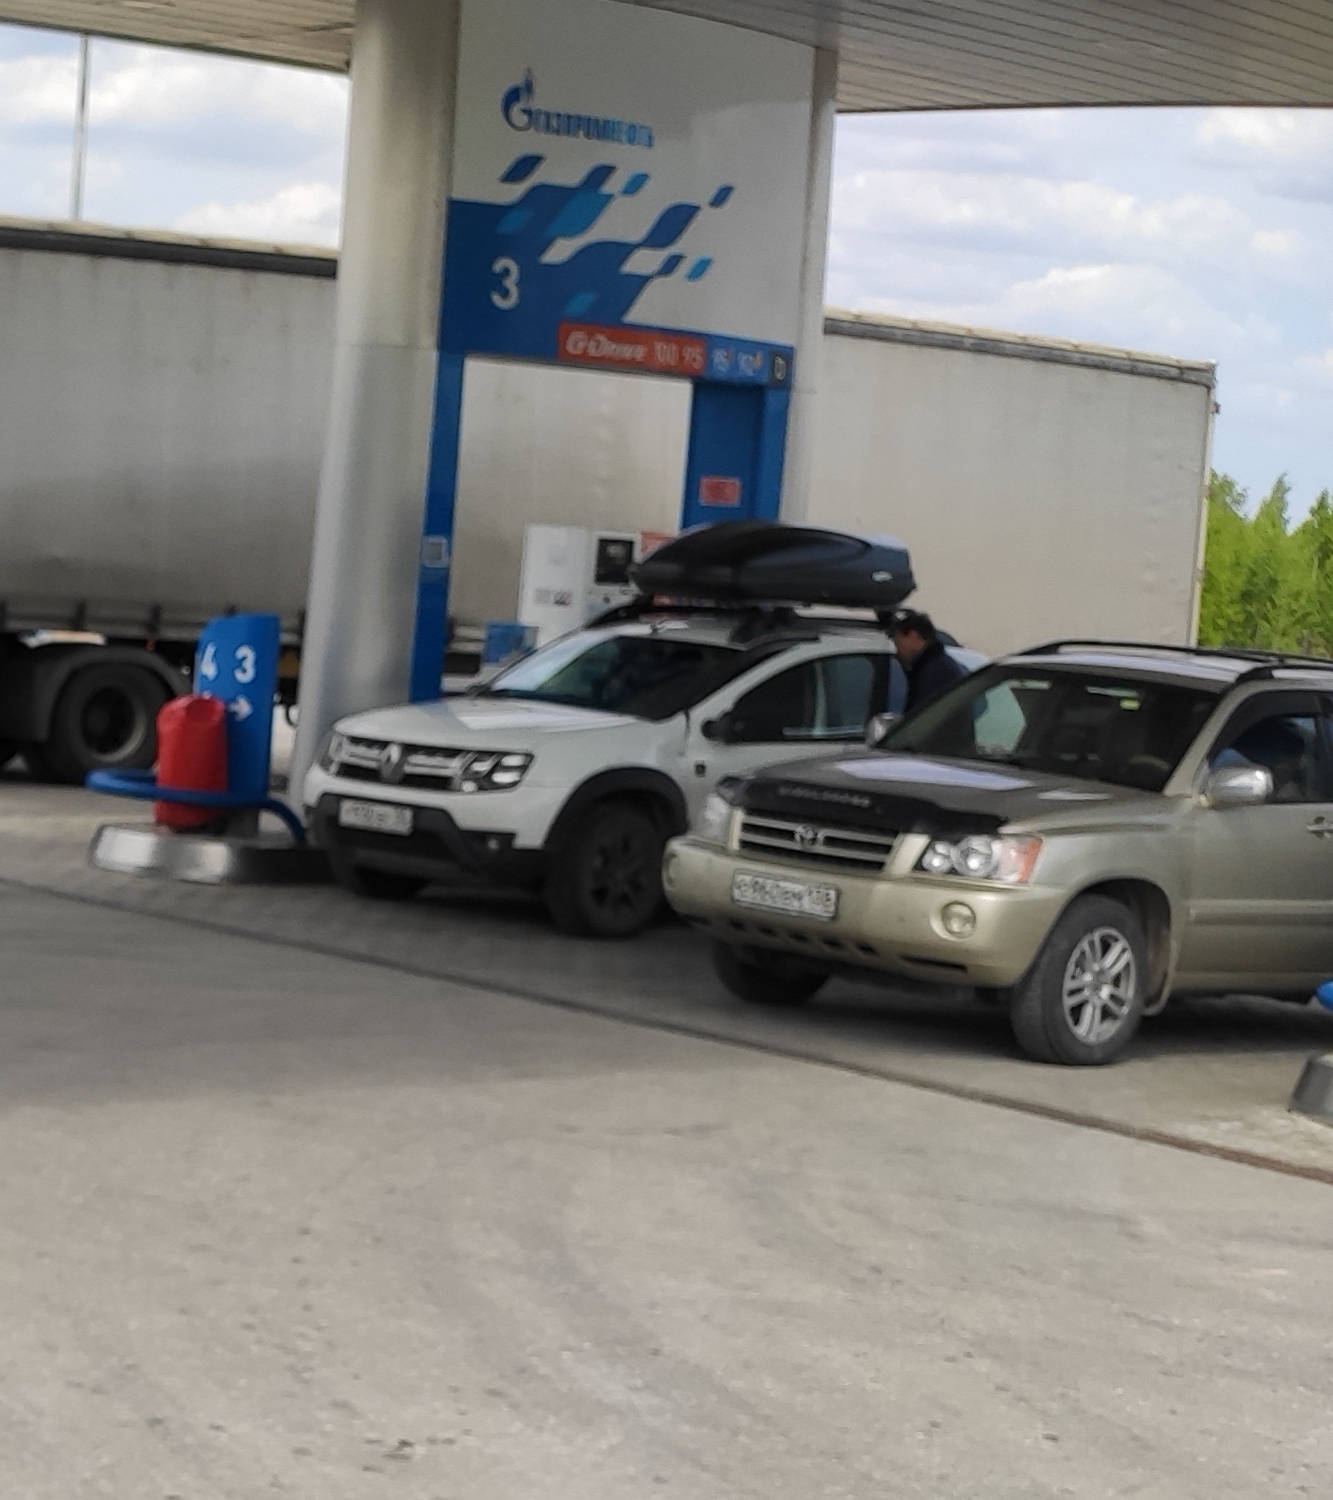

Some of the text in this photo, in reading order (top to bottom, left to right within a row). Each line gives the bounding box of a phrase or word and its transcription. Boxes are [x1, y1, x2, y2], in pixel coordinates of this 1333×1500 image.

[490, 256, 521, 311] 3
[199, 641, 257, 684] 4 3
